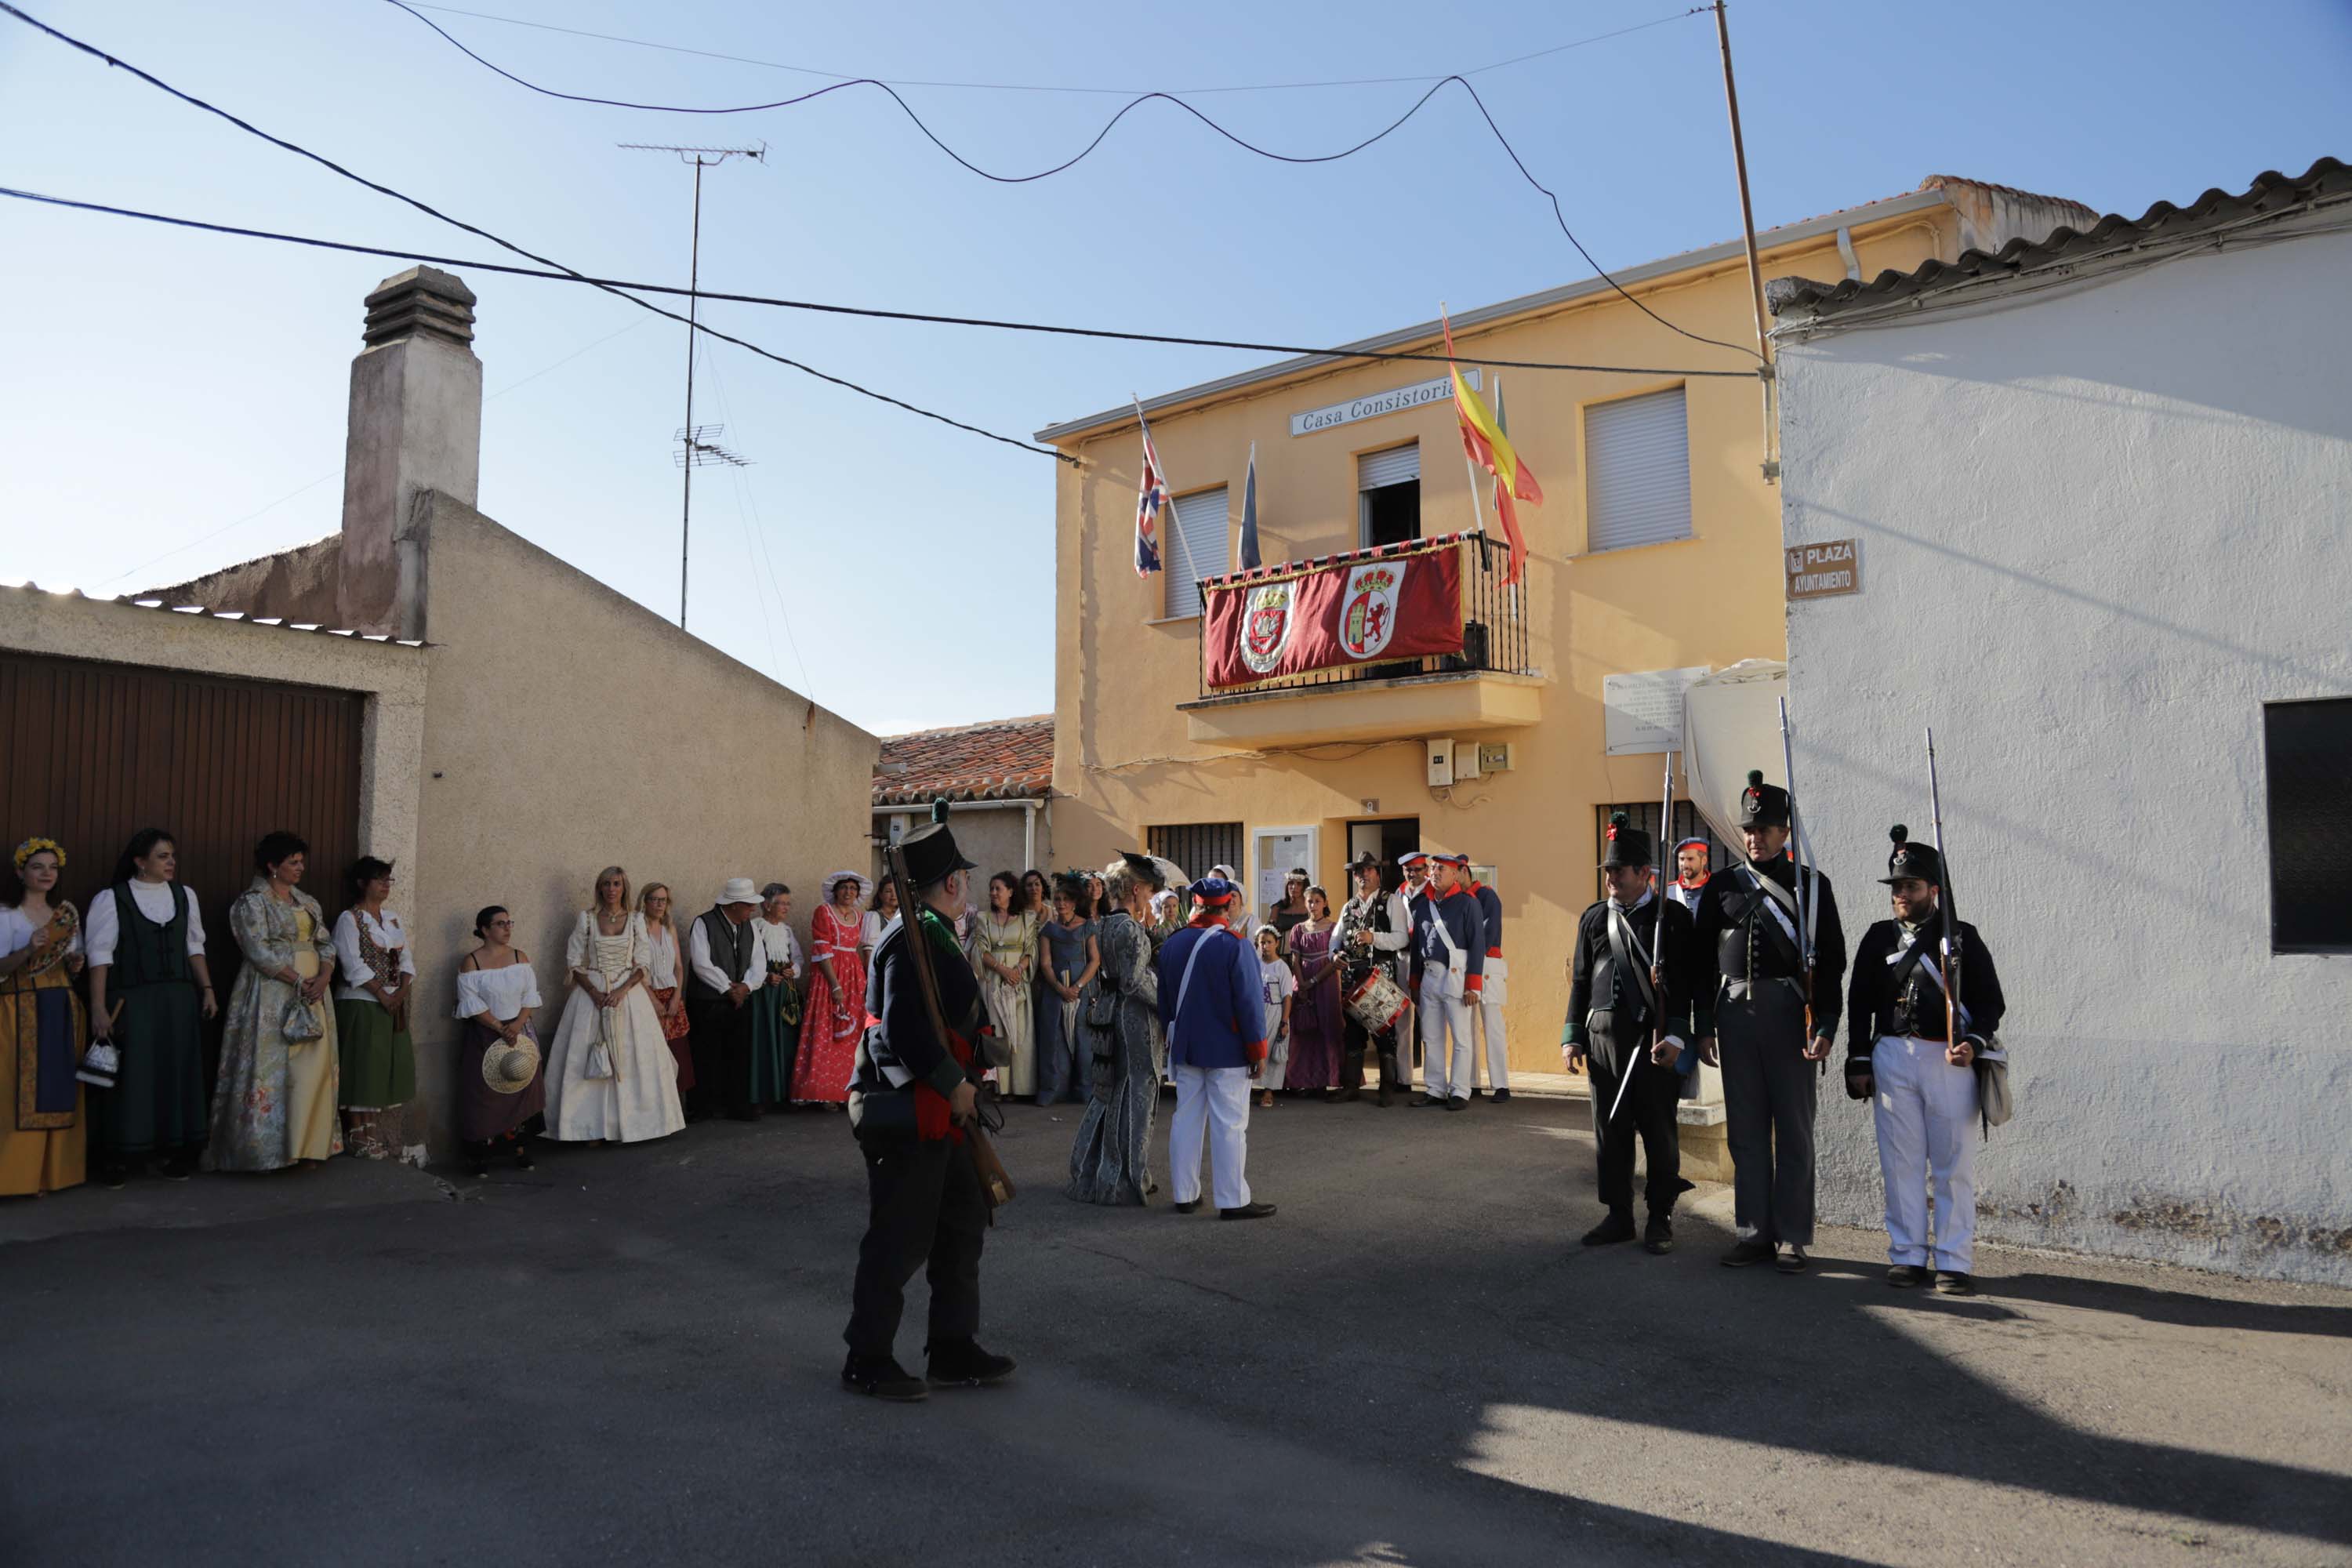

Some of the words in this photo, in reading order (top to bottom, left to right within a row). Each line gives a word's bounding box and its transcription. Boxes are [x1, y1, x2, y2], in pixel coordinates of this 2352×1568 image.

[1303, 411, 1342, 430] Casa
[1351, 375, 1465, 418] Consistoria
[1806, 546, 1853, 564] PLAZA
[1795, 570, 1851, 593] AYUNTAMIENTO
